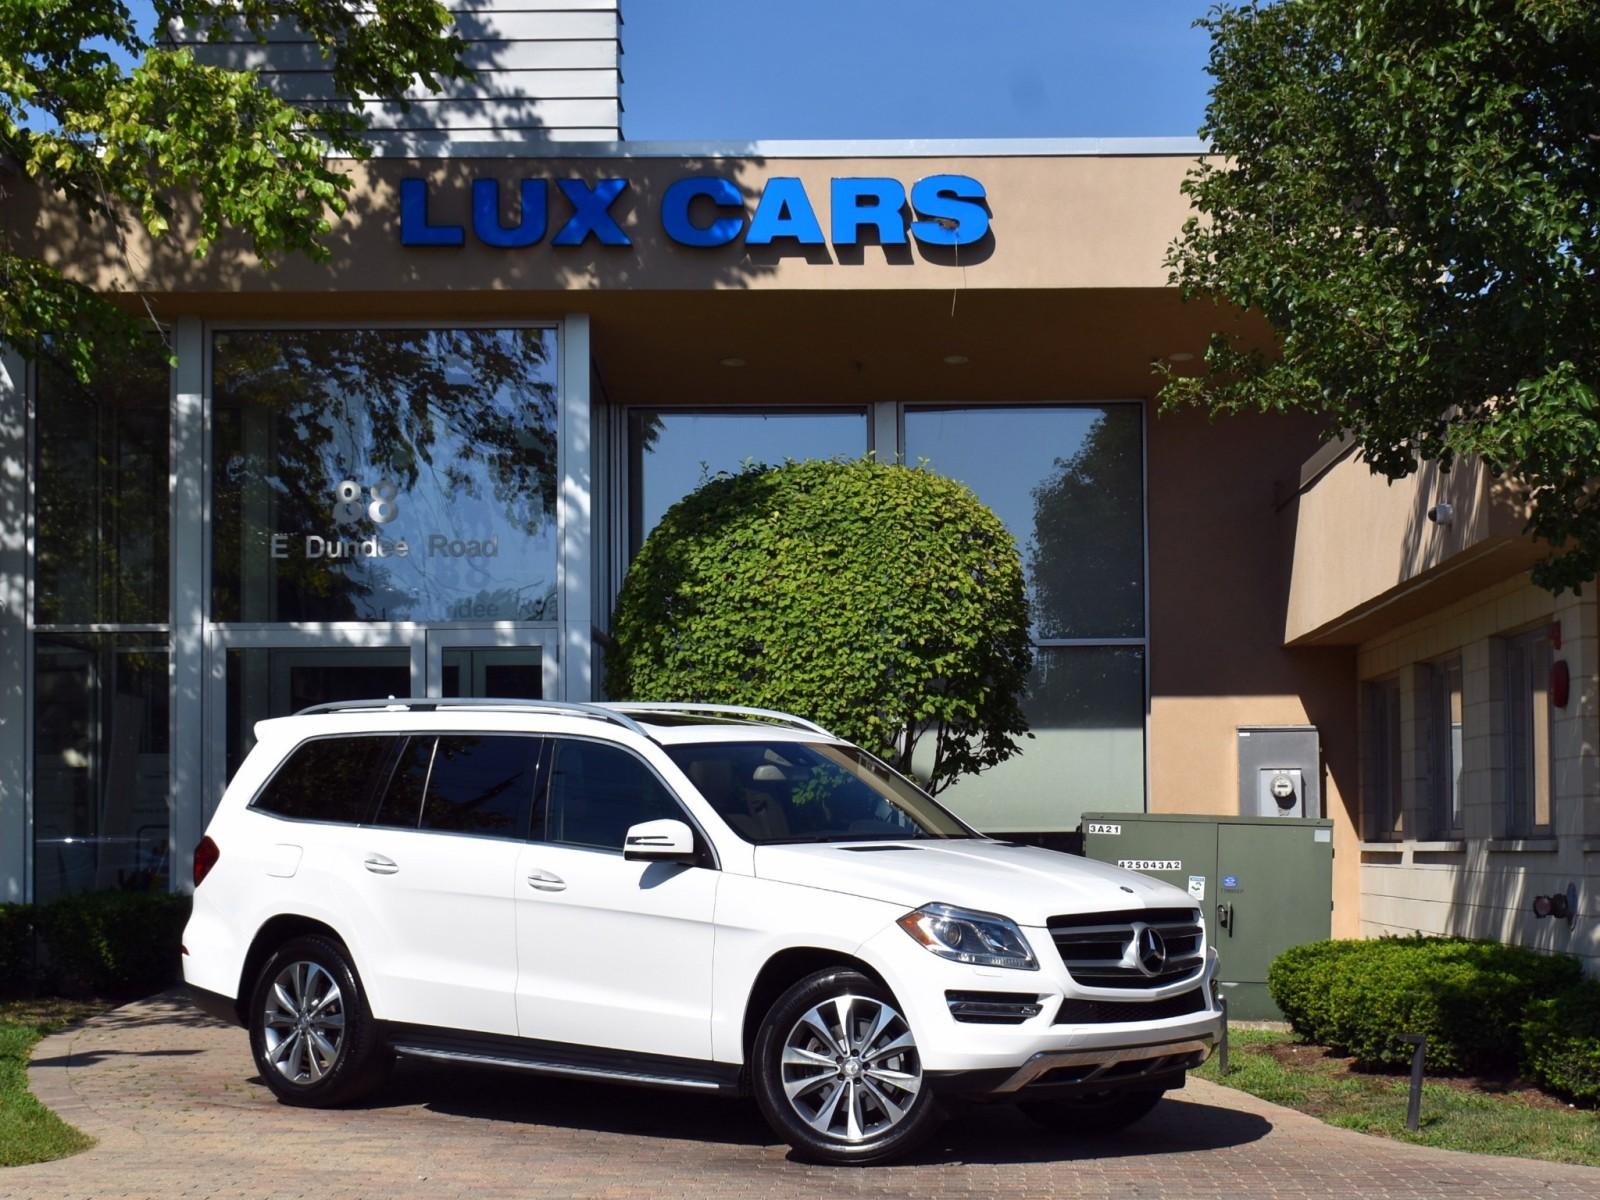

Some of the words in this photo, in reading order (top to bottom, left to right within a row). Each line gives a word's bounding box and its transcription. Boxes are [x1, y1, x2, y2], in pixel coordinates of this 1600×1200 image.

[400, 177, 633, 247] LUX
[661, 174, 991, 247] CARS
[332, 480, 398, 525] 88
[270, 535, 289, 558] E
[305, 534, 409, 559] Dundee
[427, 533, 498, 558] Road
[1089, 824, 1119, 834] 3A21
[1119, 861, 1180, 870] 425043A2
